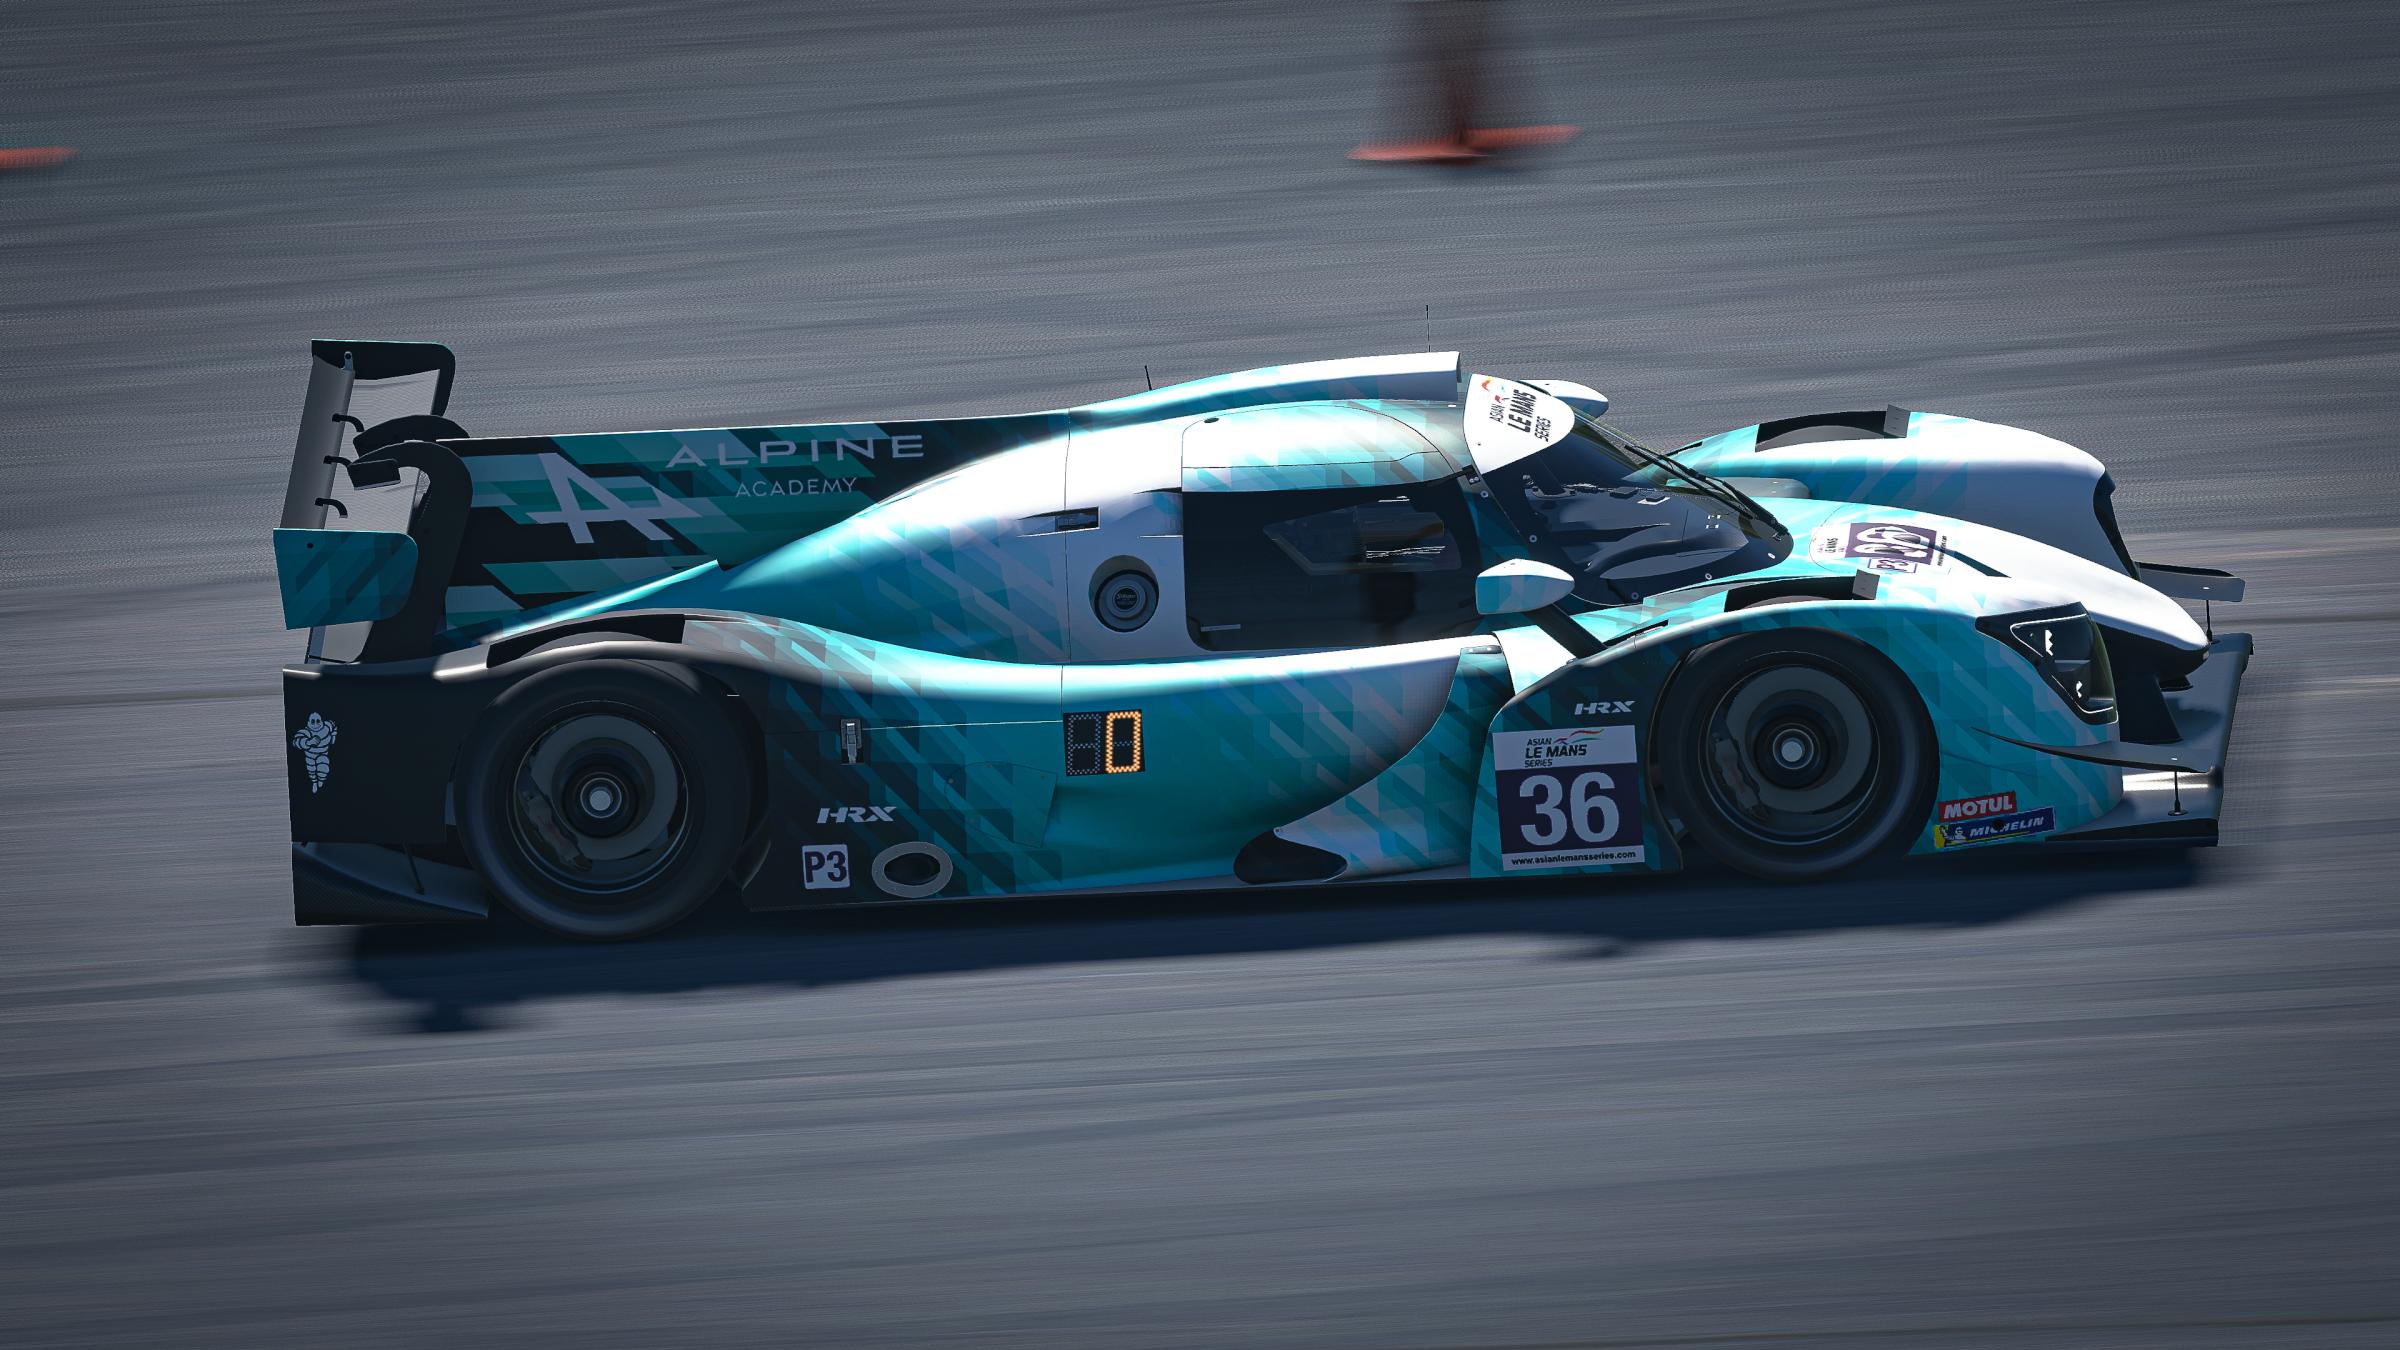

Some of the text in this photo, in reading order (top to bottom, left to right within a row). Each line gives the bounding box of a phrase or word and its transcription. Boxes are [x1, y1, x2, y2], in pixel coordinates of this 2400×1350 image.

[1489, 403, 1506, 424] ASIAN
[1507, 389, 1537, 433] LE MANS
[1534, 415, 1551, 443] SERIES
[666, 434, 924, 468] ALPINE
[735, 477, 857, 498] ACADEMY
[1574, 700, 1636, 716] HRX
[1525, 744, 1588, 759] LE MANS
[1526, 737, 1553, 746] ASIAN
[1524, 758, 1553, 768] SERIES
[816, 806, 897, 824] HRX
[1519, 771, 1620, 846] 36
[1943, 795, 2013, 819] MOTUL
[804, 850, 848, 883] P3
[1511, 850, 1637, 866] www.asianlemansseries.com
